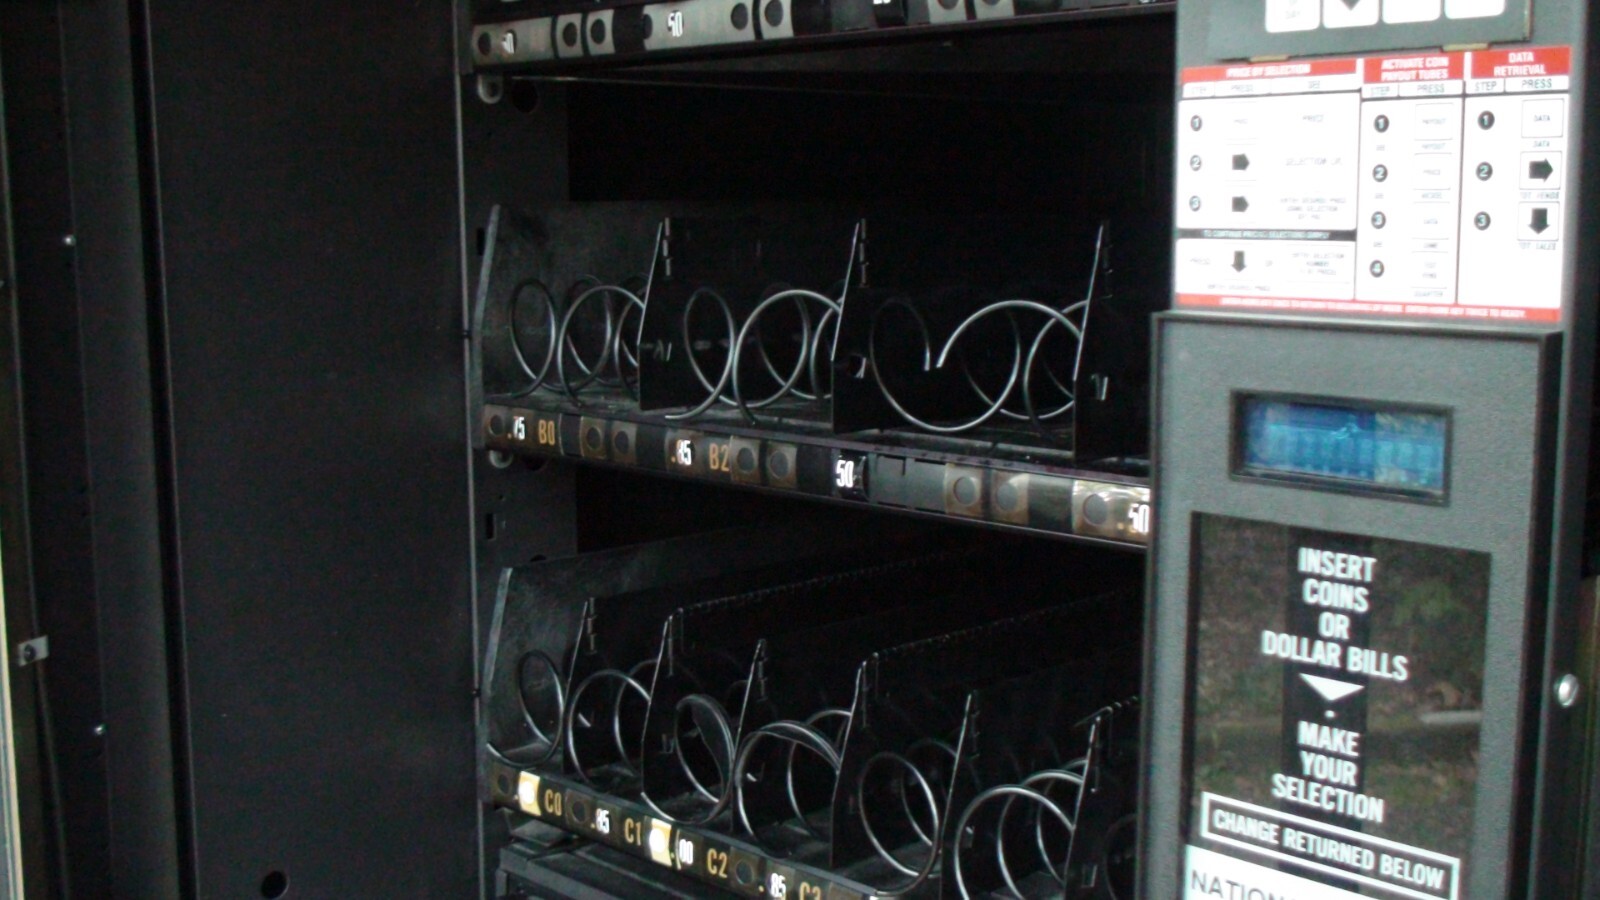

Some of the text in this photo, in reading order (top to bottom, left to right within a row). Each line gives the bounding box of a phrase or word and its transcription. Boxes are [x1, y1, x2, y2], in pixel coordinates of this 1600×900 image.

[1494, 64, 1546, 77] RETRIEVAL
[1508, 51, 1534, 63] DATA
[1417, 83, 1445, 94] PRESS
[1419, 68, 1448, 80] TUBES
[1475, 80, 1497, 92] STEP
[1522, 78, 1552, 89] PRESS
[1533, 114, 1550, 122] DATA
[709, 443, 730, 472] B2
[836, 460, 854, 488] 50
[1298, 548, 1377, 583] INSERT
[1302, 578, 1369, 613] COINS
[1318, 612, 1350, 640] OR
[1261, 630, 1408, 681] DOLLAR BILLS
[1298, 721, 1360, 757] MAKE
[1301, 751, 1357, 787] YOUR
[1272, 774, 1384, 823] SELECTION
[624, 817, 641, 846] C1
[707, 848, 728, 879] C2
[1213, 808, 1445, 890] CHANGE RETURNED BELOW
